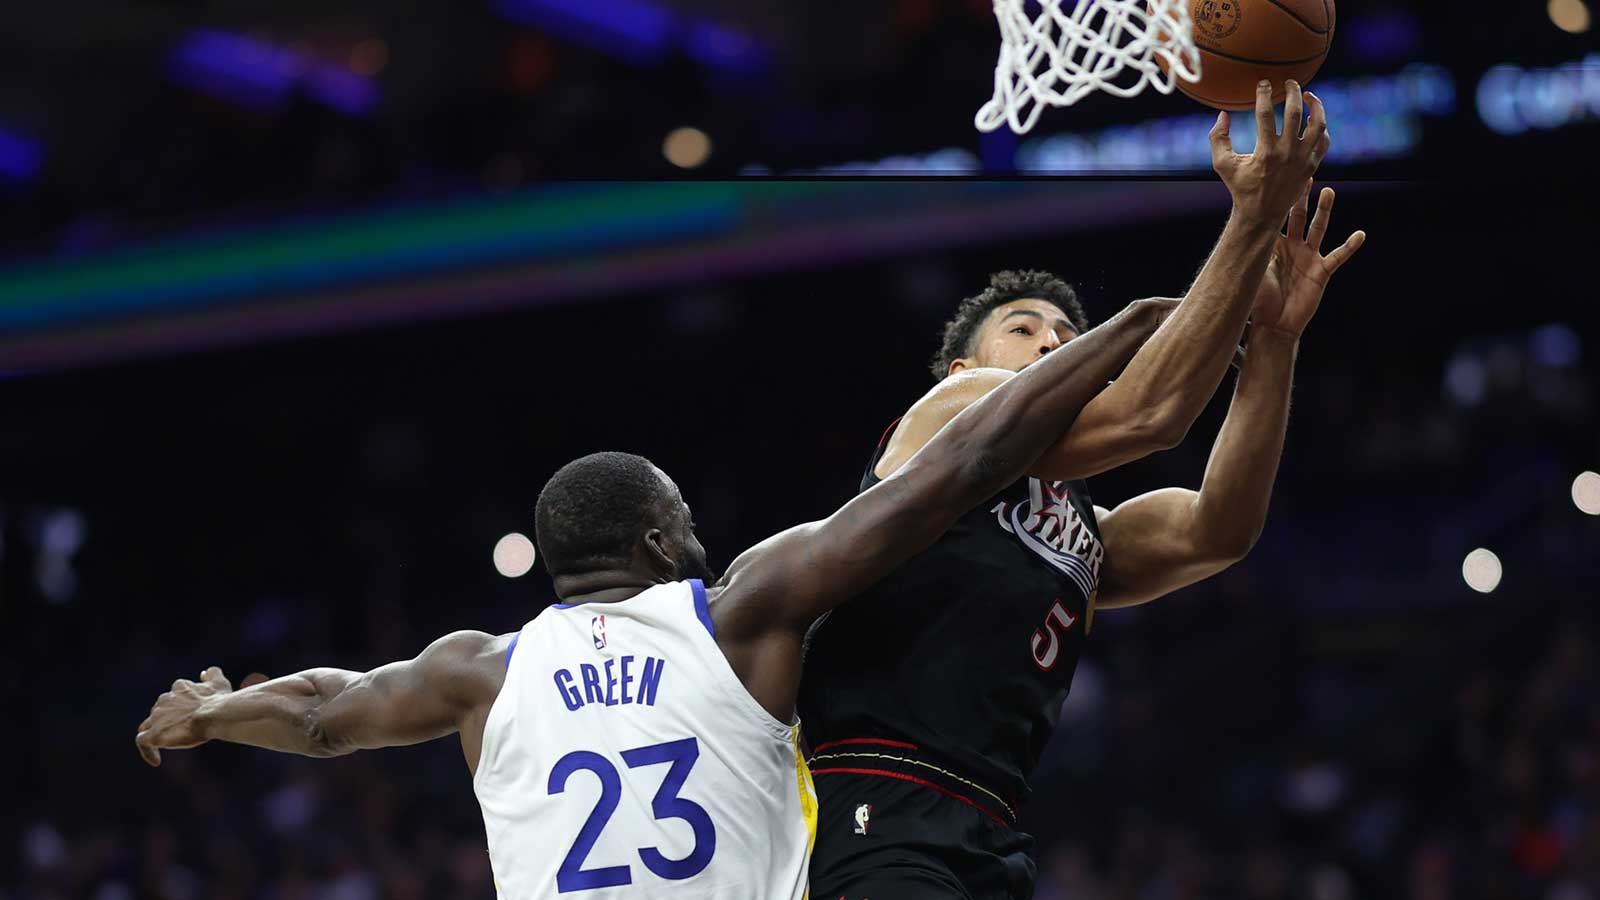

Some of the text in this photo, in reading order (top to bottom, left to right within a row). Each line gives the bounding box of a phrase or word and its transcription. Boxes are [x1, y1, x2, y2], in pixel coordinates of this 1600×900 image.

[1031, 599, 1078, 670] 5
[553, 655, 665, 711] GREEN
[547, 737, 716, 893] 23
